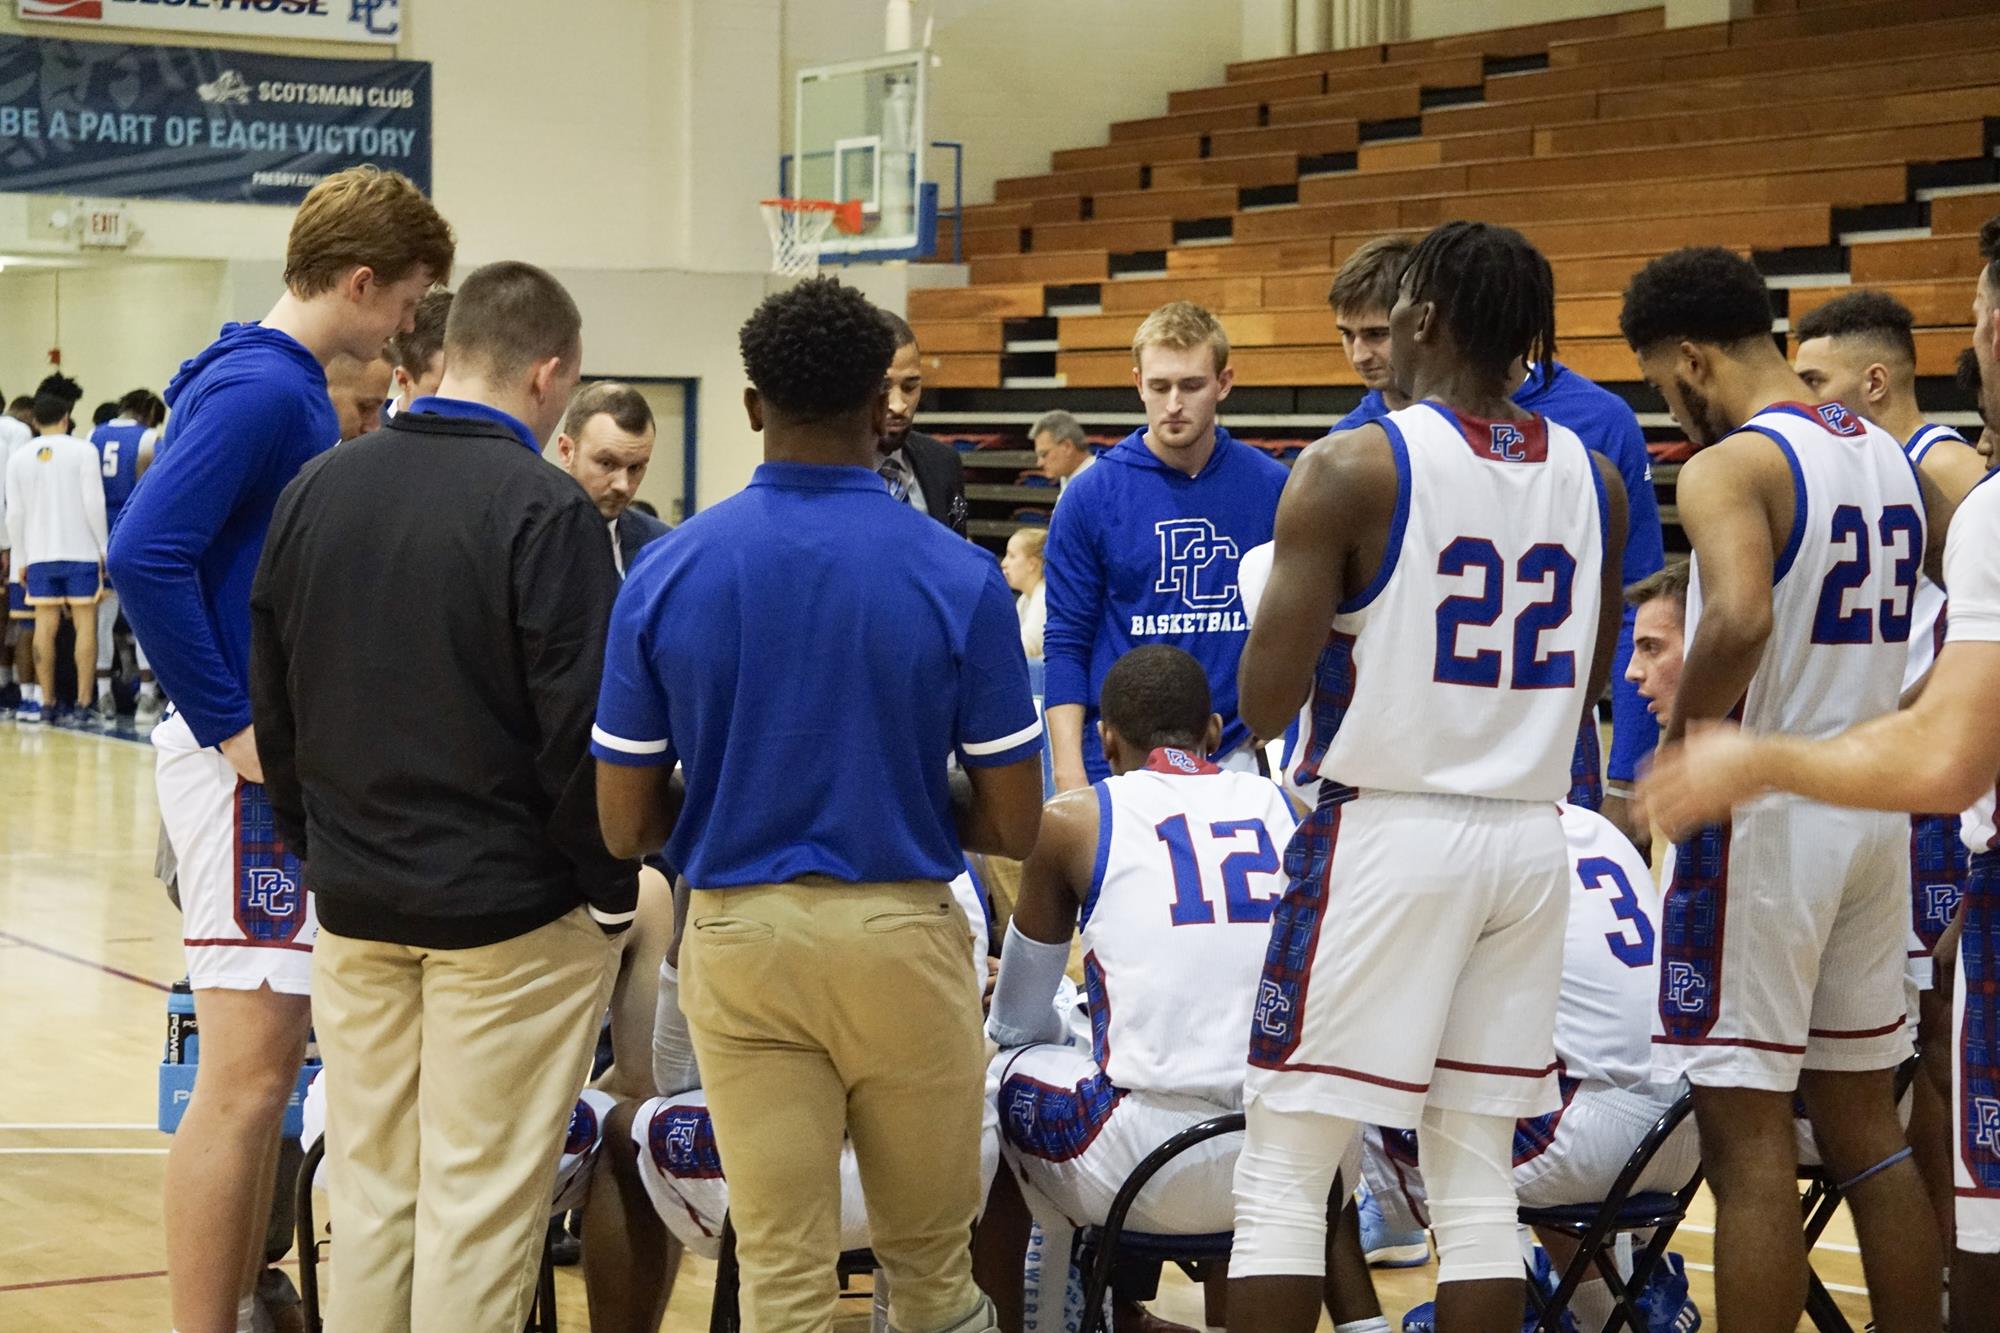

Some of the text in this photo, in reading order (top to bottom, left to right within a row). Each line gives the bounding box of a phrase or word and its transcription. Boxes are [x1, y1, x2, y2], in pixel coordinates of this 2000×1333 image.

[258, 81, 414, 108] SCOTSMAN CLUB
[1, 106, 415, 157] BE A PART OF EACH VICTORY
[92, 213, 118, 234] EXIT
[102, 441, 120, 477] 5
[1490, 424, 1525, 461] PC
[1155, 518, 1239, 609] PC
[1810, 504, 1923, 644] 23
[1433, 535, 1577, 690] 22
[249, 868, 295, 916] PC
[1155, 812, 1281, 927] 12
[1576, 855, 1656, 968] 3
[1254, 979, 1290, 1037] PC
[1668, 962, 1706, 1012] PC
